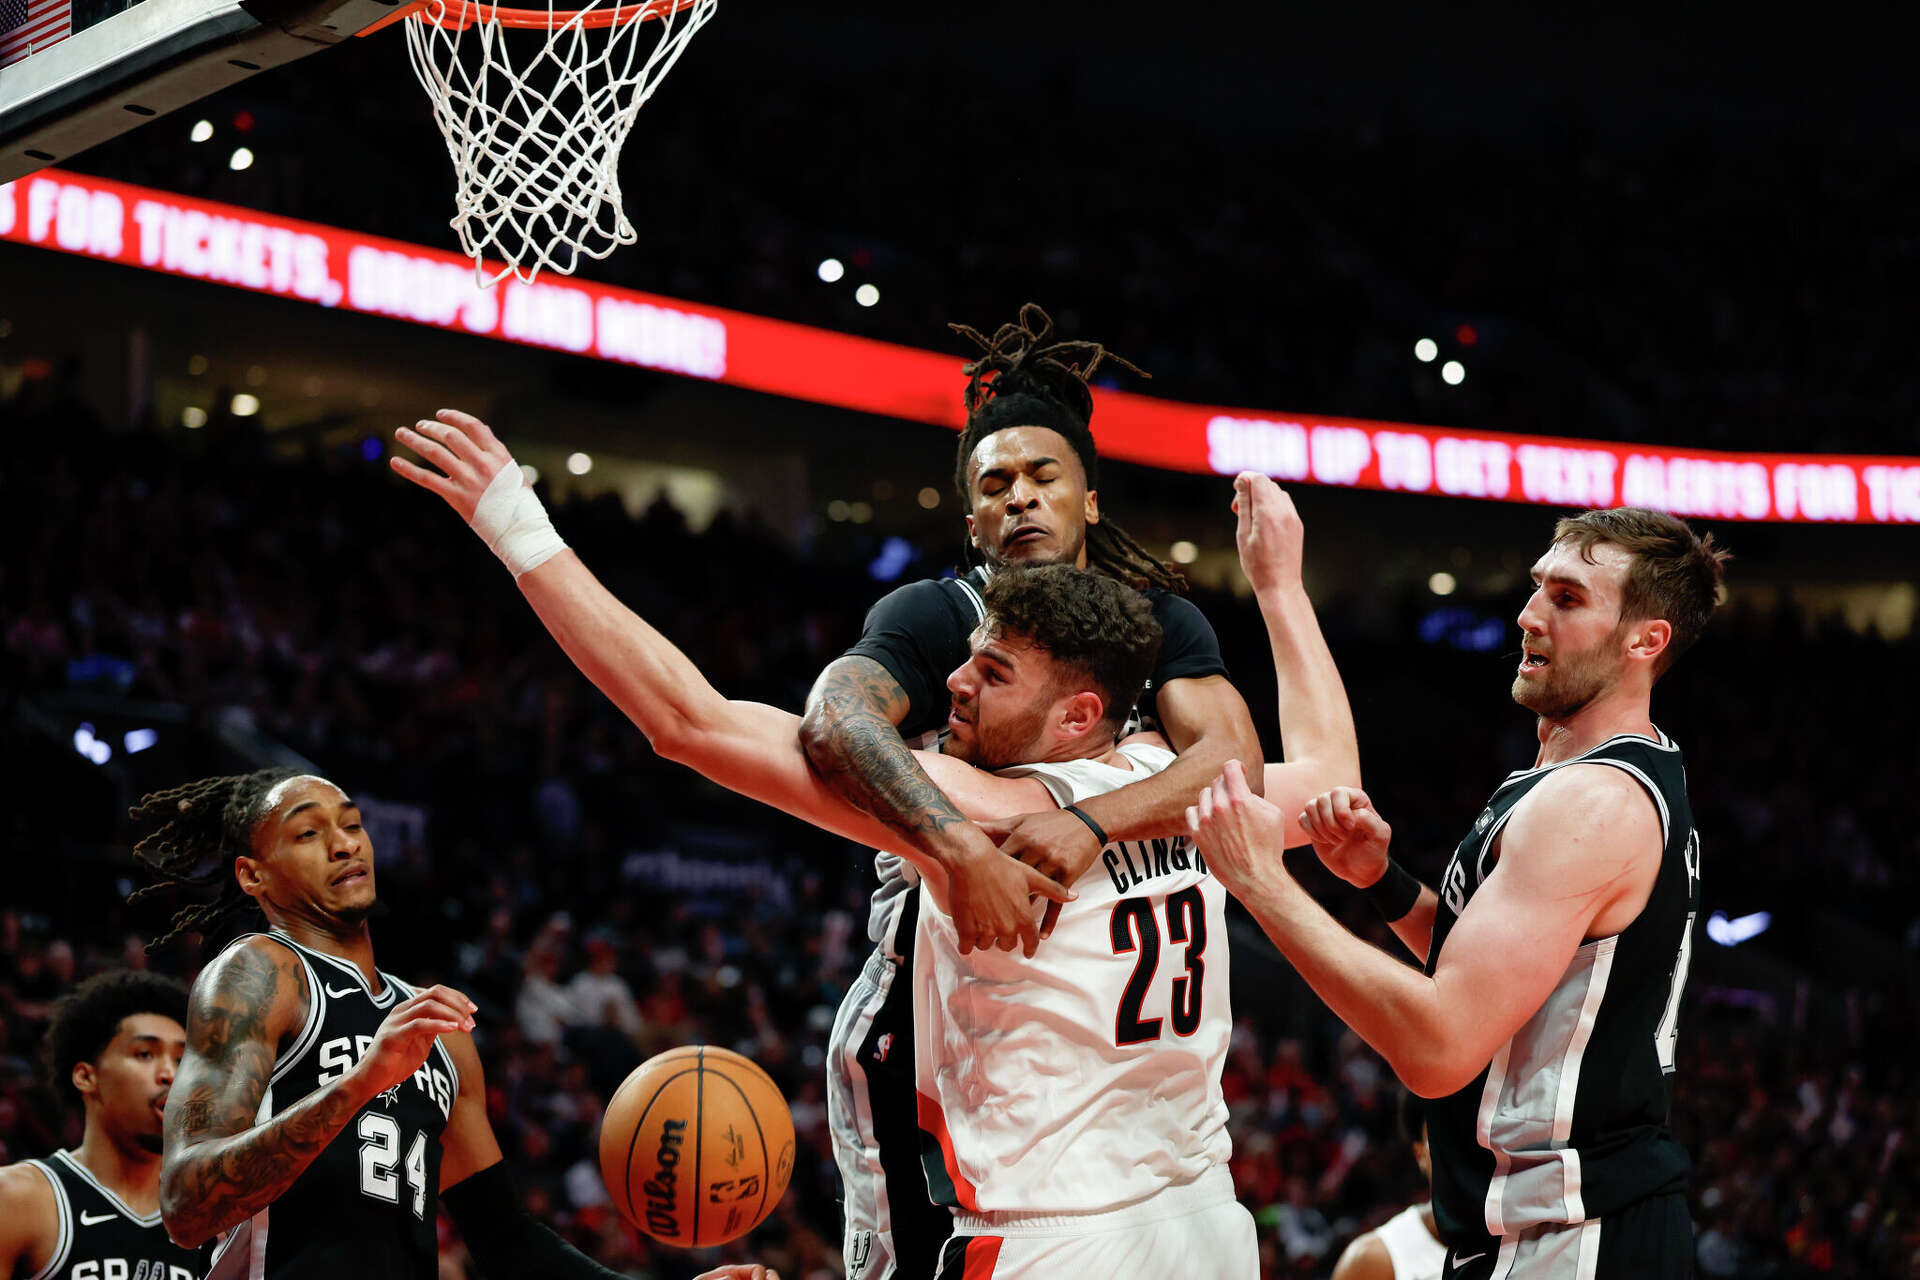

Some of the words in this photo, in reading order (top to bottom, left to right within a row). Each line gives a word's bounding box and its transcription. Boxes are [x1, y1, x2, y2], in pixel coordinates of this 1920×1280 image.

[28, 178, 124, 258] FOR
[133, 200, 343, 307] TICKETS,
[1206, 415, 1309, 480] SIGN
[1310, 425, 1372, 486] UP
[1372, 431, 1433, 493] TO
[1434, 437, 1511, 499] GET
[1515, 444, 1618, 508] TEXT
[1621, 453, 1770, 520] ALERTS
[1772, 463, 1858, 521] FOR
[1110, 884, 1207, 1047] 23
[358, 1110, 428, 1221] 24
[643, 1118, 688, 1238] Wilson
